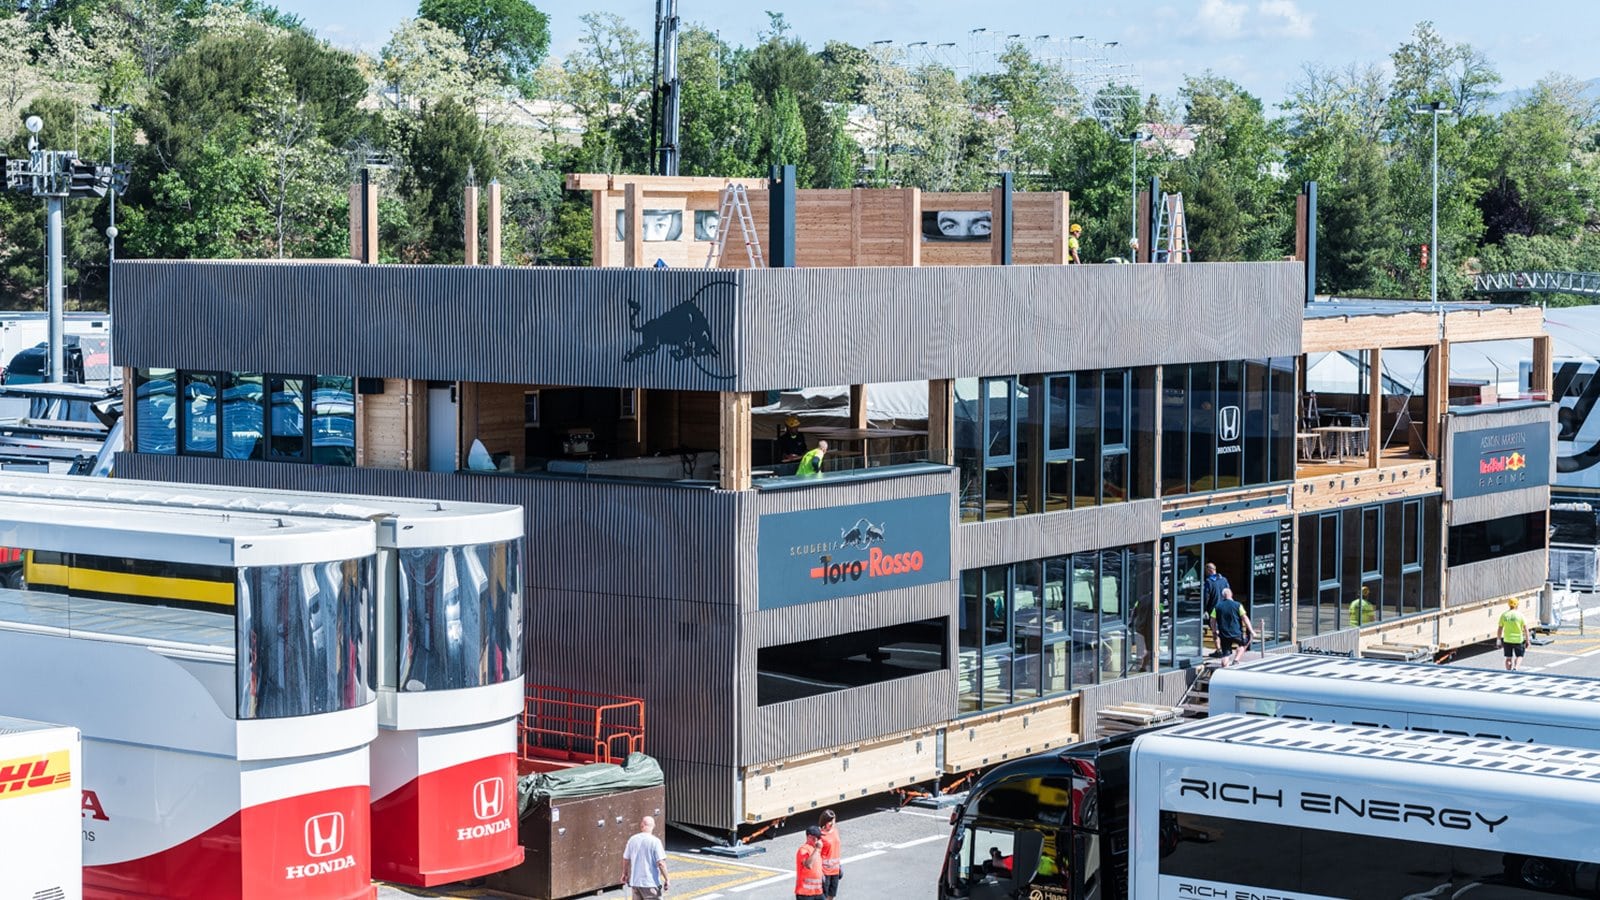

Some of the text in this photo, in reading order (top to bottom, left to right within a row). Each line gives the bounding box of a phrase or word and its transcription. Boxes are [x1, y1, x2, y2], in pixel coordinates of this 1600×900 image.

[1217, 445, 1241, 454] HONDA
[1479, 472, 1525, 487] RACING
[790, 541, 839, 556] SCUDERIA
[820, 547, 924, 585] Toro Rosso
[0, 759, 56, 793] HL
[1180, 778, 1509, 833] RICH ENERGY
[457, 818, 512, 841] HONDA
[285, 855, 357, 880] HONDA
[1178, 883, 1228, 899] RICH
